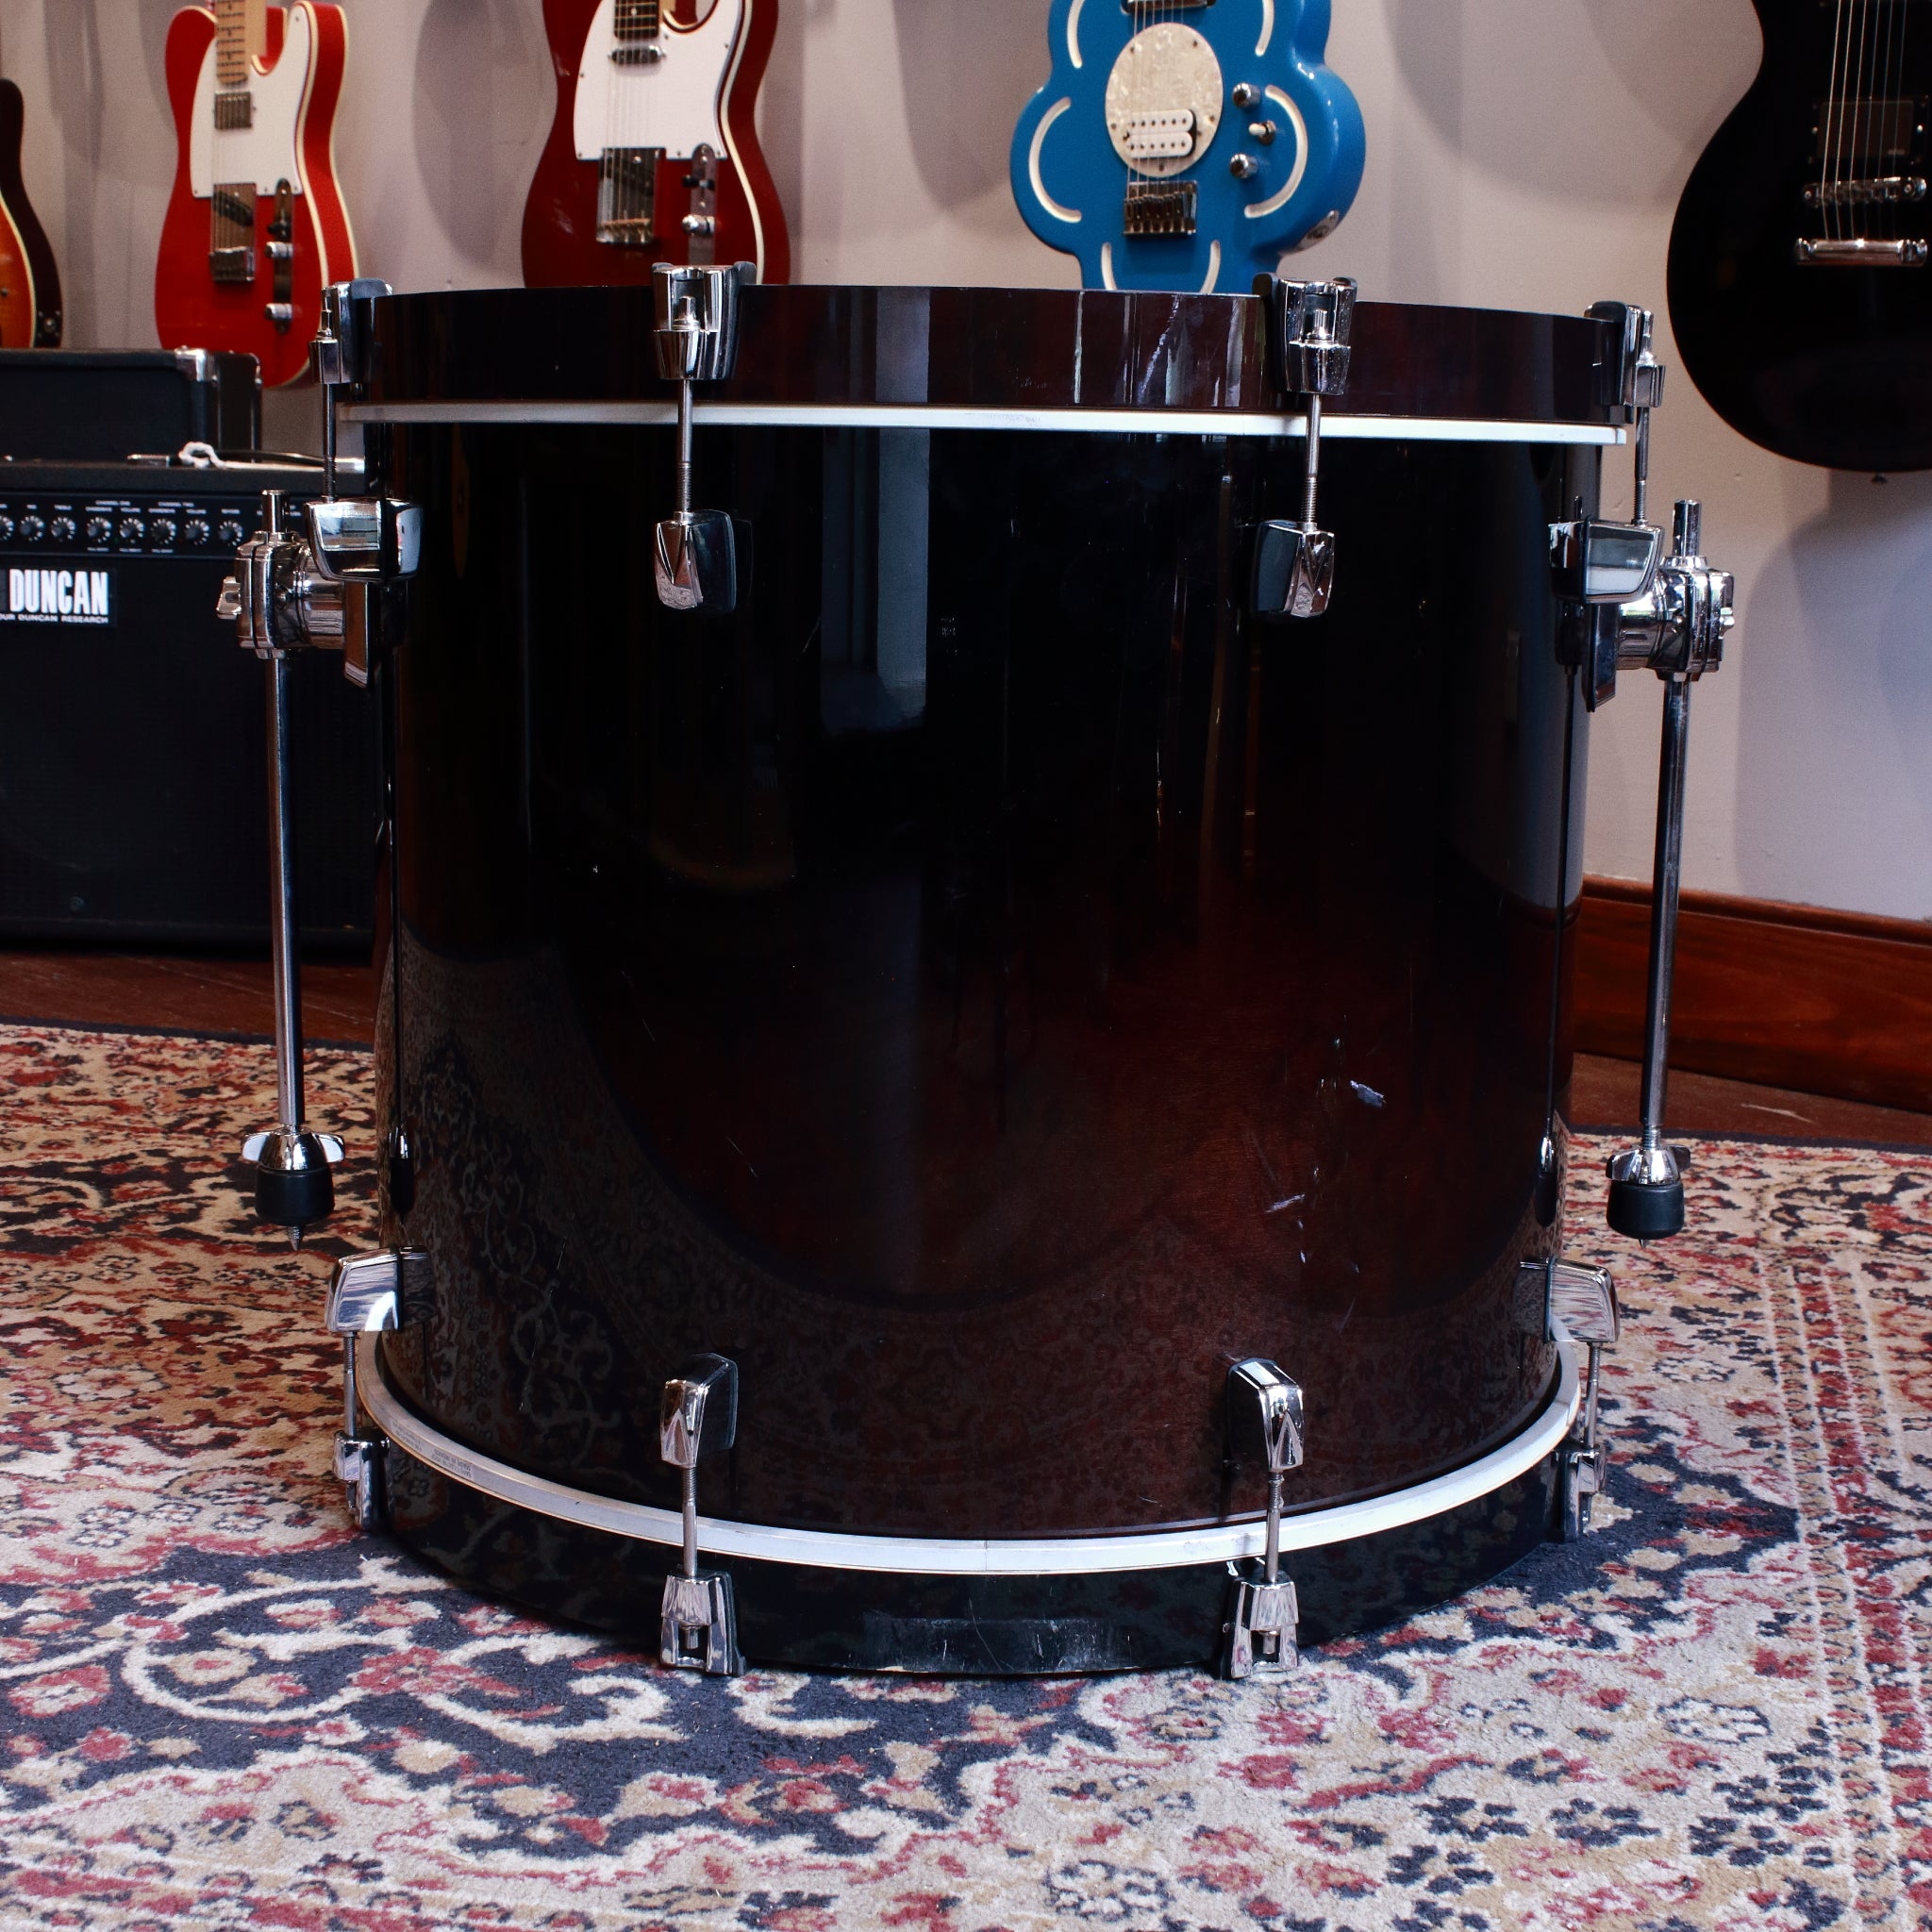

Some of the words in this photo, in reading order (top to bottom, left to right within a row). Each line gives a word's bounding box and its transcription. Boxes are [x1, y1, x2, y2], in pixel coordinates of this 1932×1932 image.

[9, 568, 108, 615] DUNCAN
[18, 613, 58, 623] DUNCAN
[61, 615, 108, 624] RESEARCH
